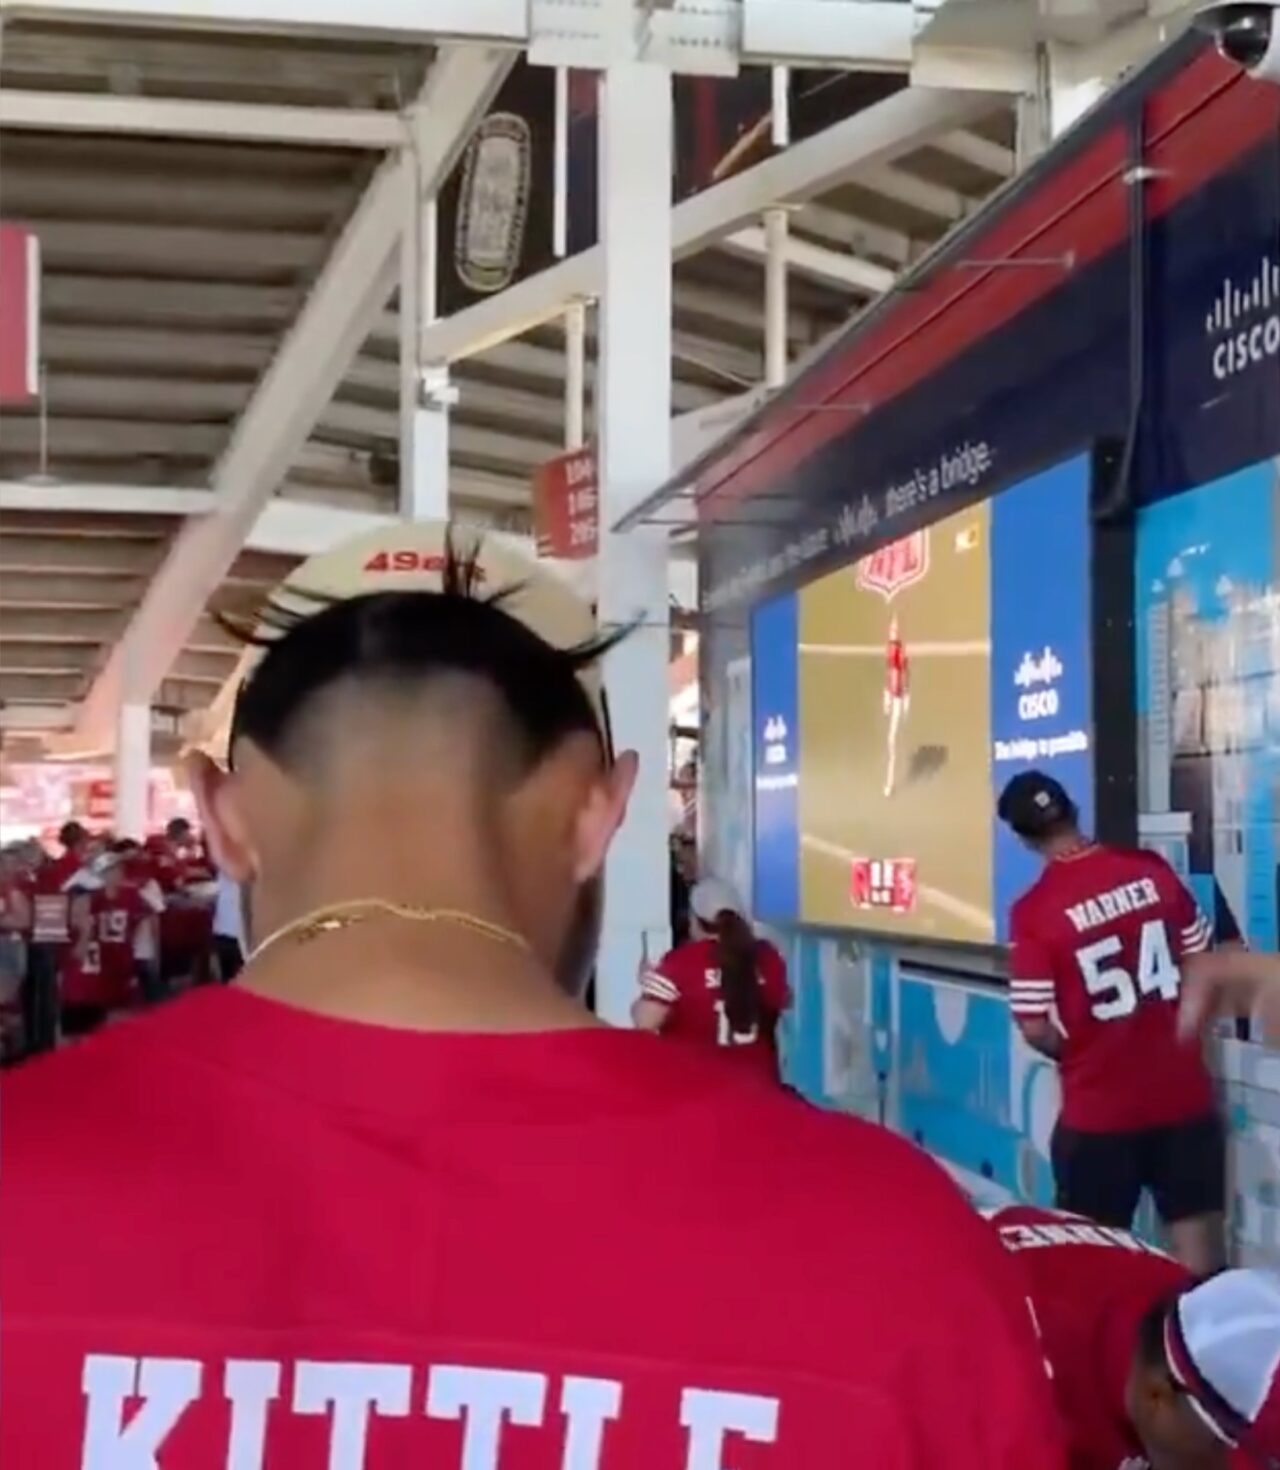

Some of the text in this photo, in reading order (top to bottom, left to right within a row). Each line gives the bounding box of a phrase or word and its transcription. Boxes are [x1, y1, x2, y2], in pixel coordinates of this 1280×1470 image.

[1213, 316, 1280, 379] CISCO
[929, 468, 939, 496] a
[364, 551, 487, 582] 49es
[1018, 688, 1059, 720] CISCO
[1065, 877, 1160, 932] WARNER
[1075, 919, 1181, 1020] 54
